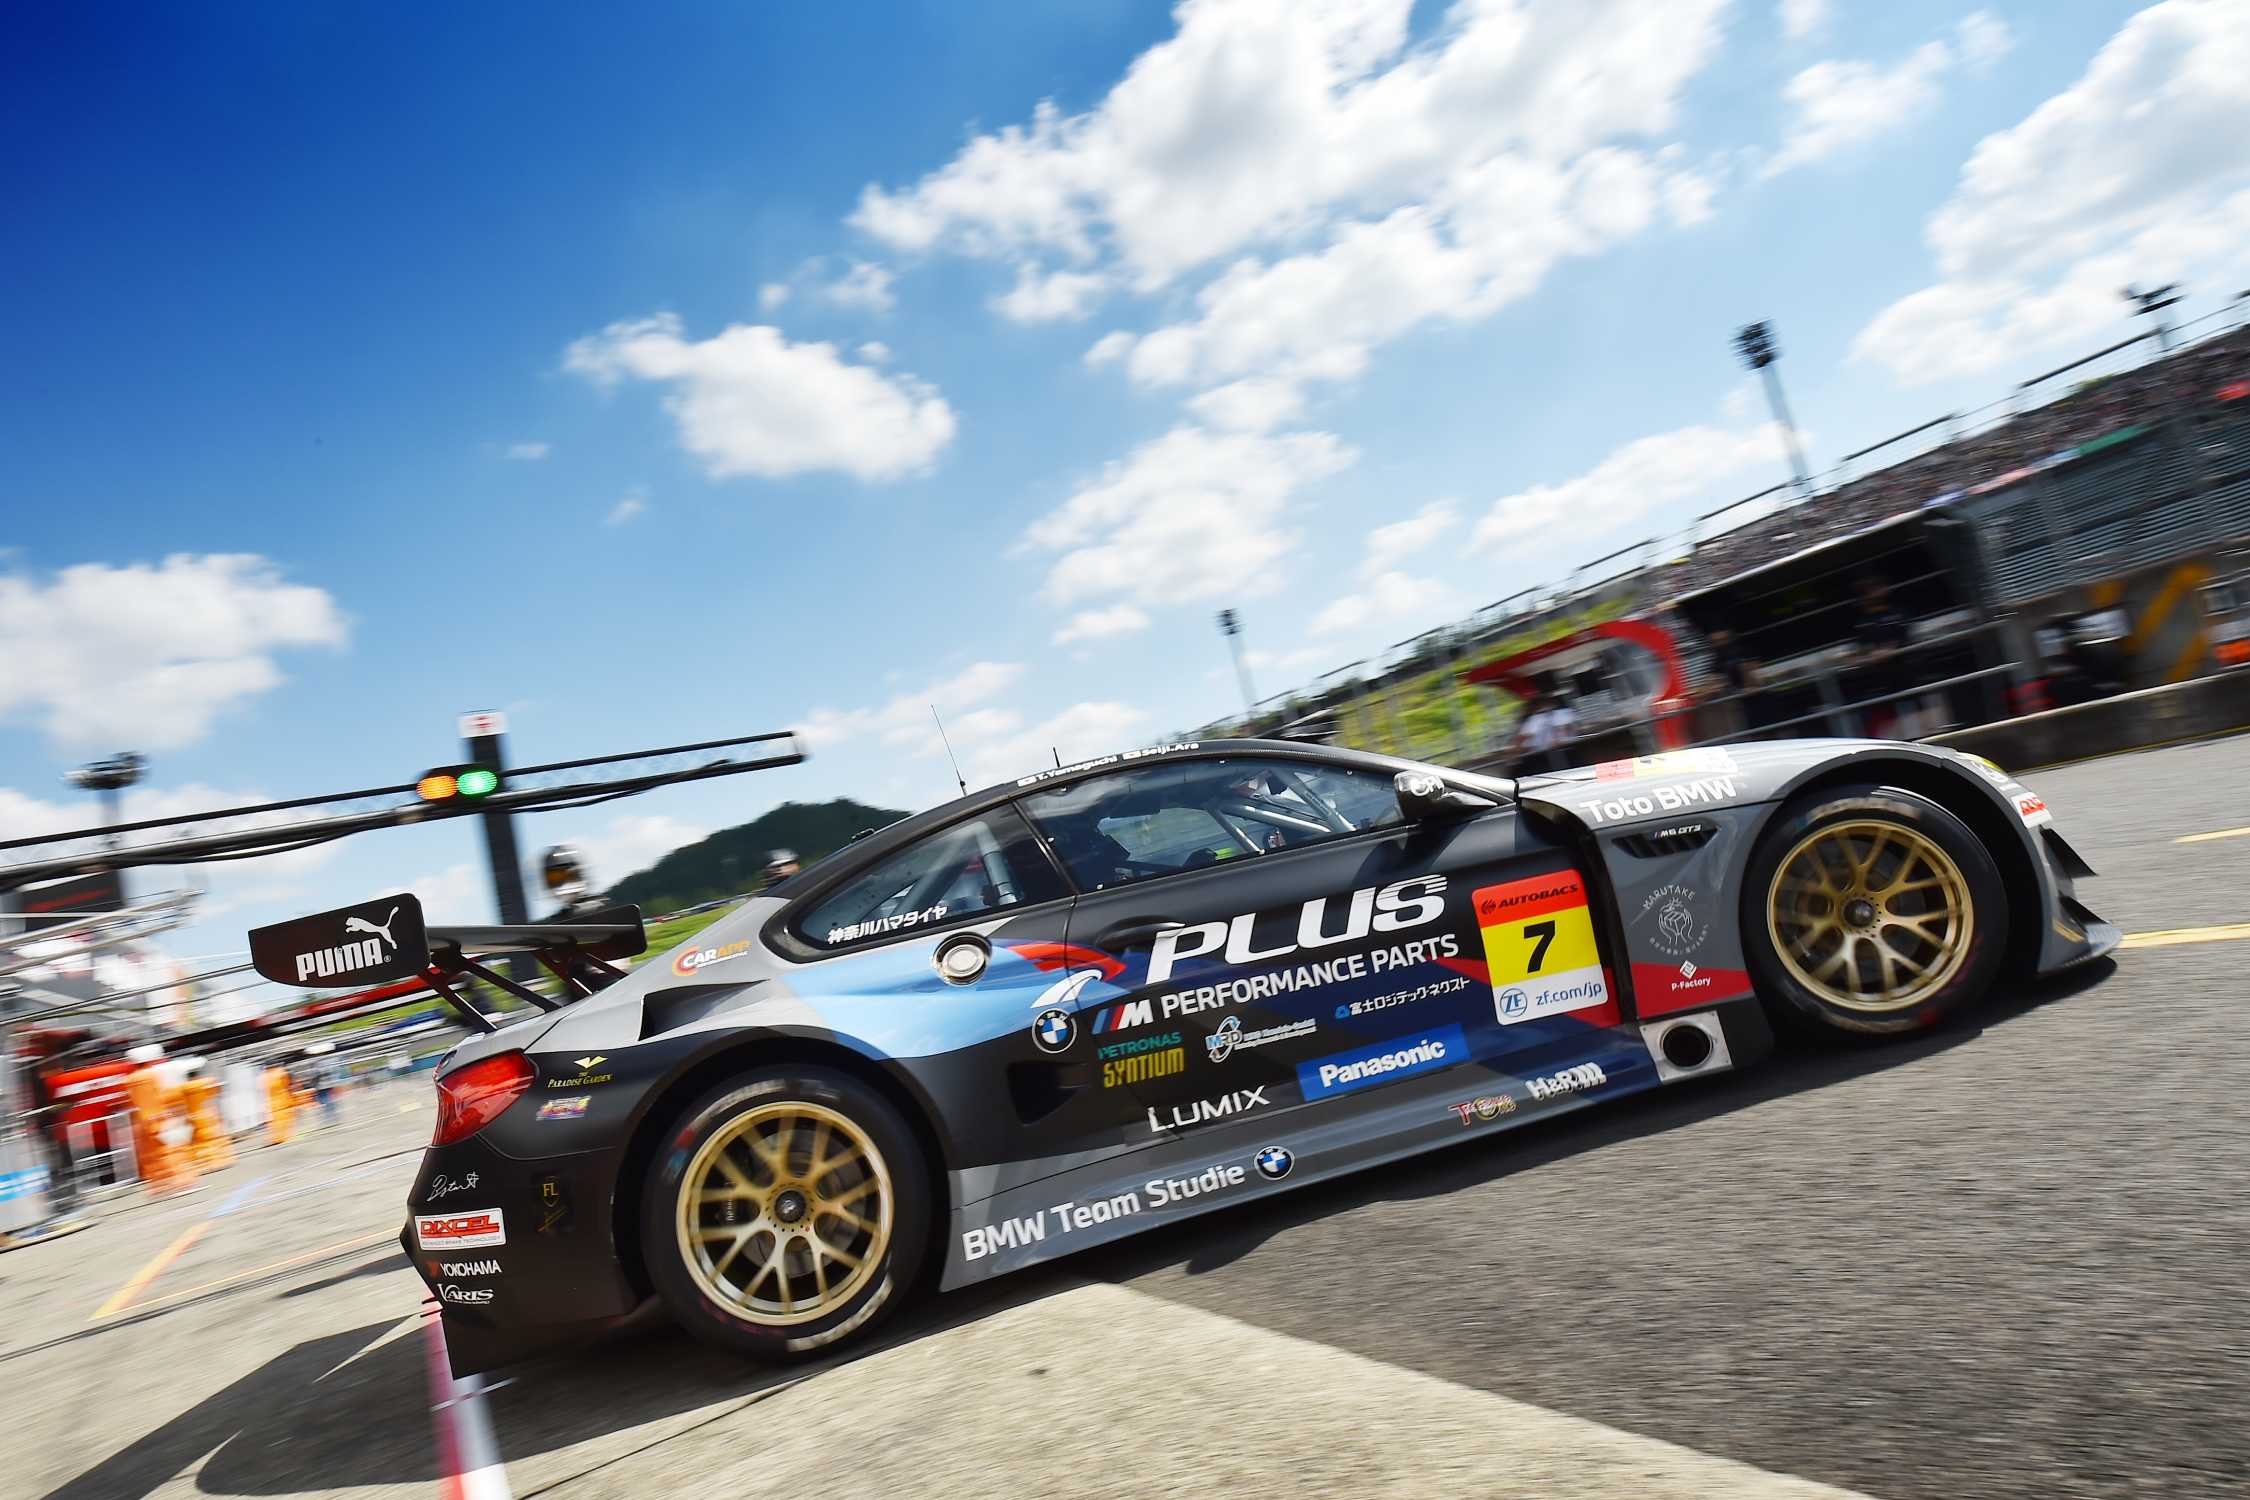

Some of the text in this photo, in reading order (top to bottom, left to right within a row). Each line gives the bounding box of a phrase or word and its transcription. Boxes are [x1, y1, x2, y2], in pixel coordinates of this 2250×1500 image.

[1579, 775, 1737, 823] Toto BMW
[1498, 884, 1578, 909] AUTOBACS
[827, 905, 948, 945] 神奈川ハマタイヤ
[1145, 874, 1448, 985] PLUS
[1523, 920, 1555, 973] 7
[296, 938, 384, 982] PUMA
[1160, 954, 1366, 1019] PERFORMANCE
[1373, 933, 1459, 974] PARTS
[1504, 981, 1602, 1014] ZF zf.com/jp
[1098, 1031, 1182, 1060] PETRONAS
[1319, 1039, 1446, 1088] Panasonic
[1103, 1047, 1185, 1089] SYNTIUM
[1146, 1084, 1271, 1133] LUMIX
[420, 1215, 500, 1237] DIXCEL
[962, 1164, 1246, 1262] BMW Team Studie
[440, 1260, 502, 1277] YOKOHAMA
[437, 1283, 494, 1301] VARIS
